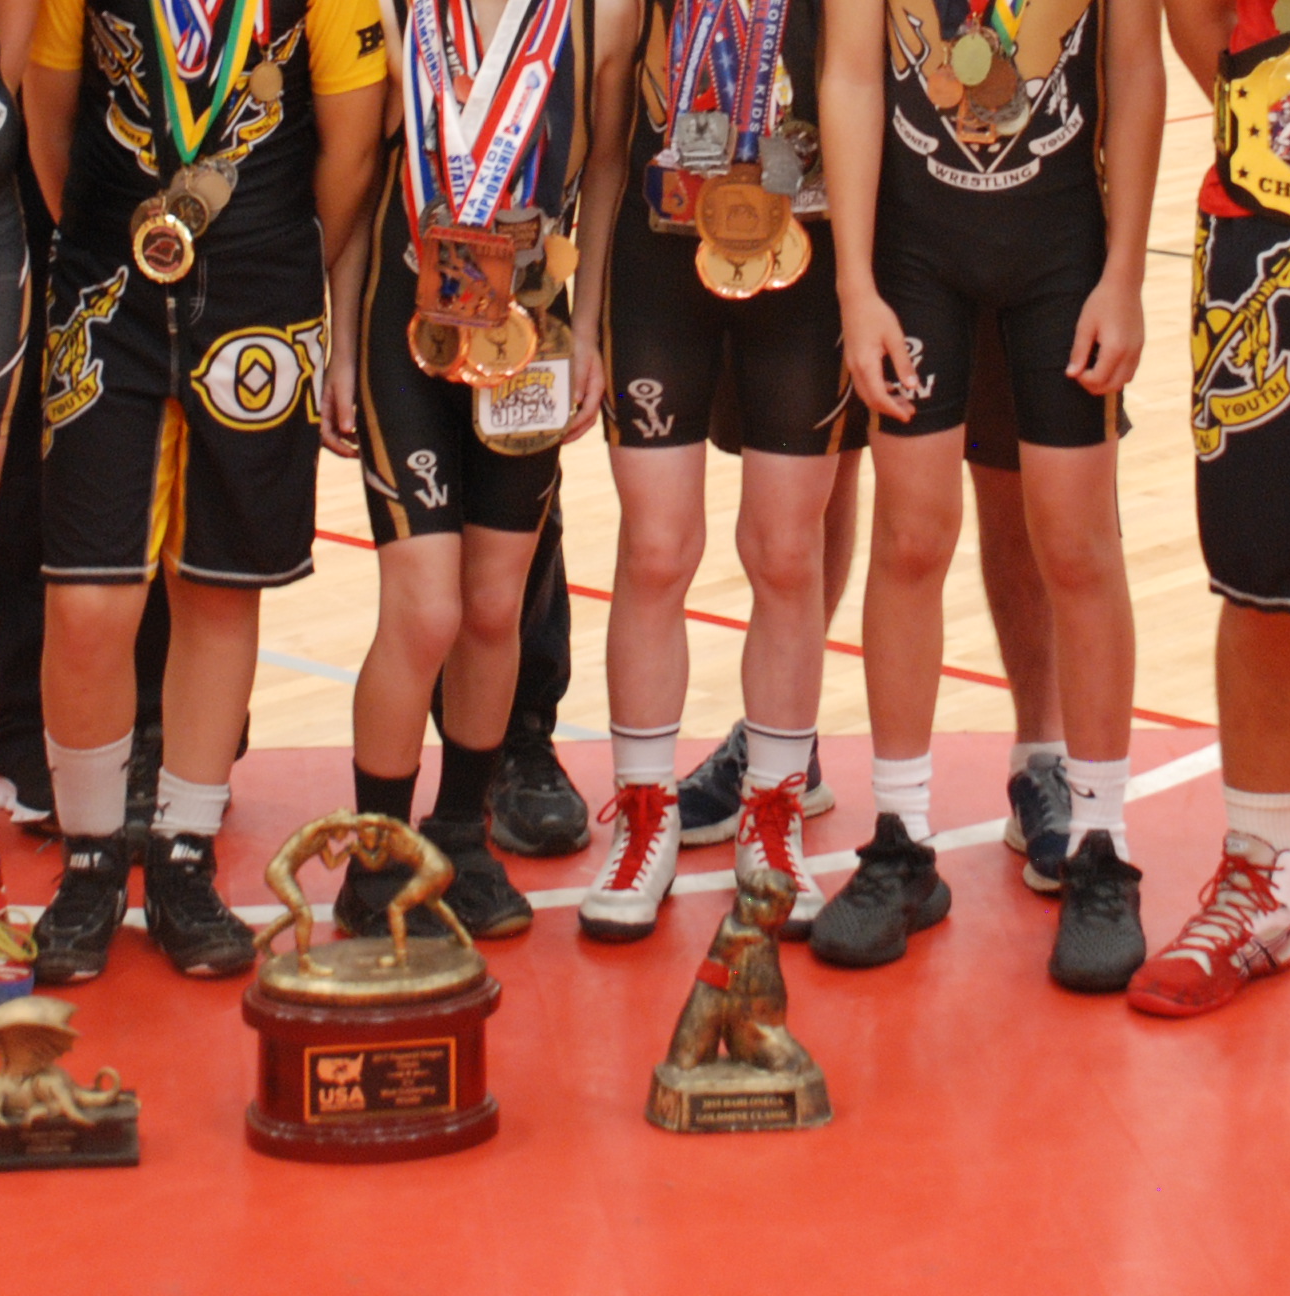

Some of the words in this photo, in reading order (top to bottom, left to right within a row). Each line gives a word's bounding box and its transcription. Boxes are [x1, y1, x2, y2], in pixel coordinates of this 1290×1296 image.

[749, 83, 765, 132] KIDS
[1040, 118, 1081, 152] YOUTH
[474, 140, 517, 220] MPIONSHIP
[935, 164, 1033, 188] WRESTLING
[627, 377, 675, 439] OYW
[1220, 382, 1285, 418] YOUTH
[407, 449, 449, 510] OYW
[319, 1085, 366, 1105] USA
